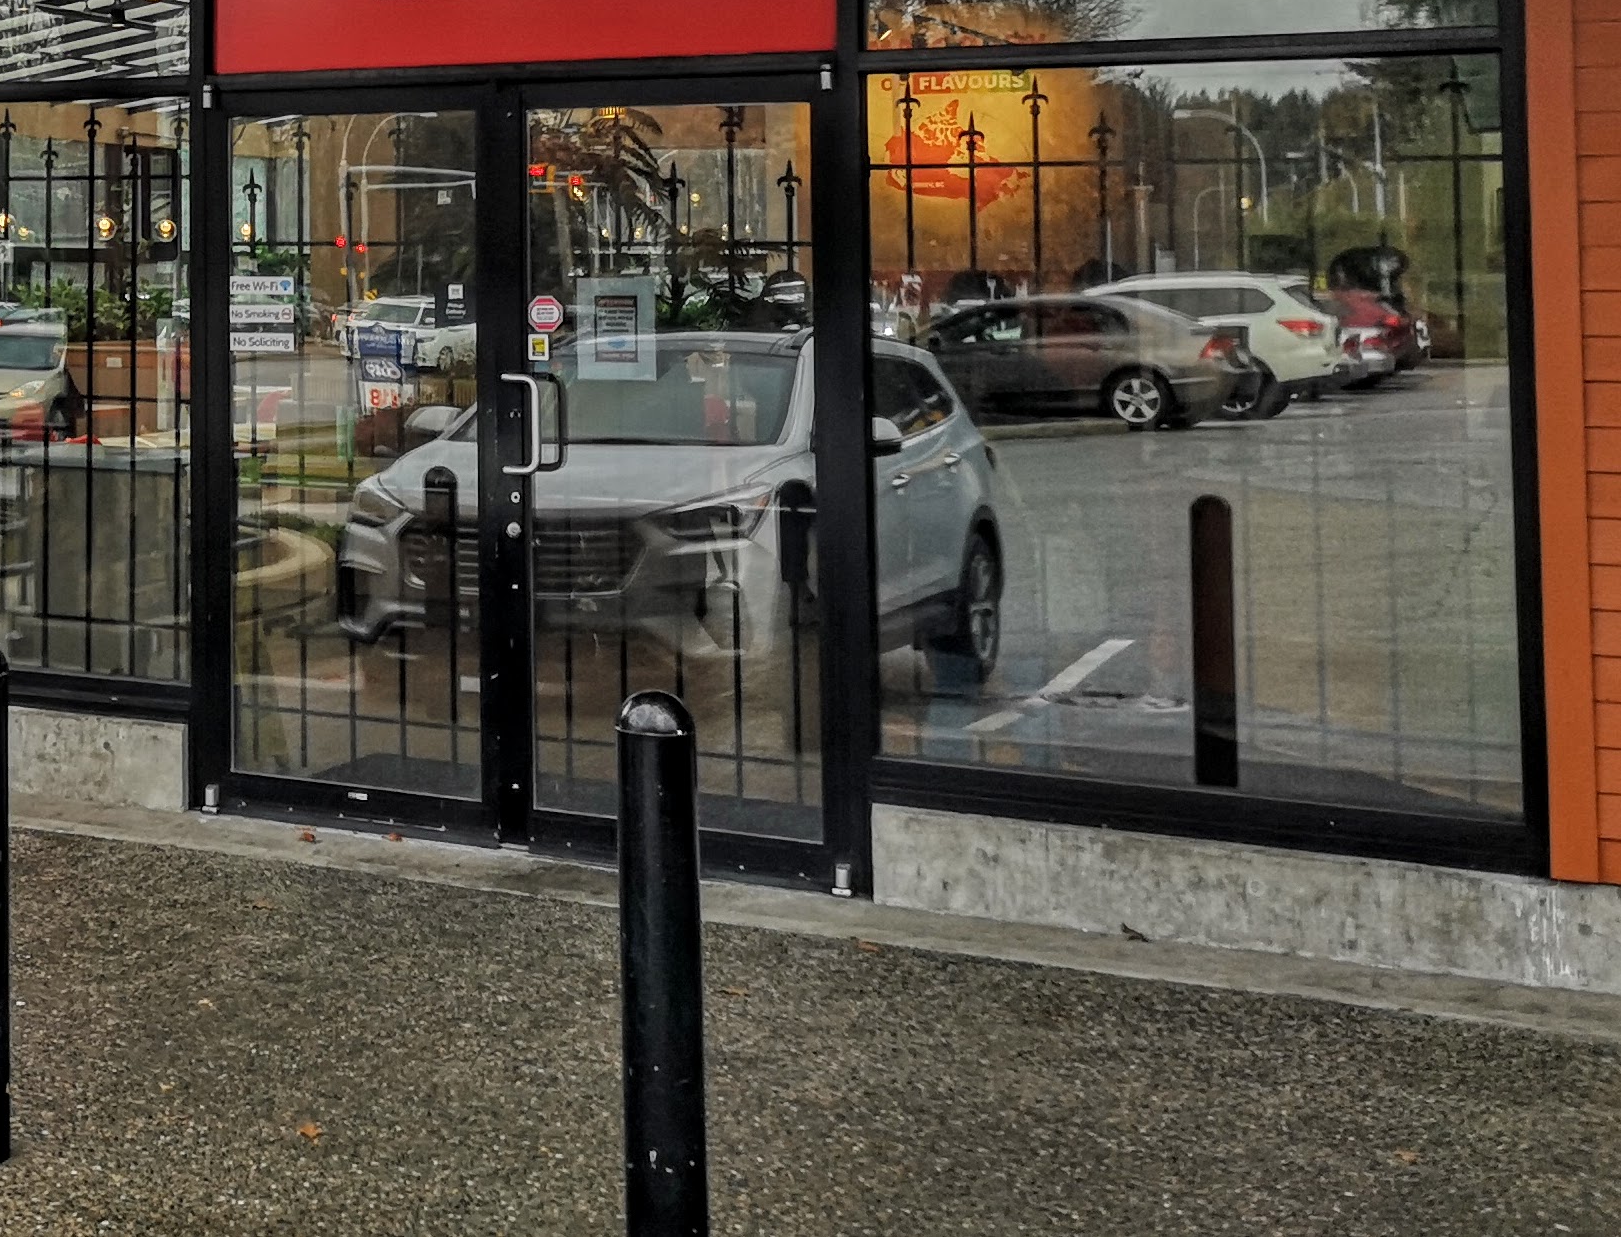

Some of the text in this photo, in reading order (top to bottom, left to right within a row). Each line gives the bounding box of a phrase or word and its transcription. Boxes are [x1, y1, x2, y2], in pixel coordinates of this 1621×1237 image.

[919, 73, 1025, 91] FLAVOURS
[231, 280, 279, 291] Free Wi-Fi
[231, 309, 280, 320] No Smoking
[233, 336, 290, 350] No Soliciting
